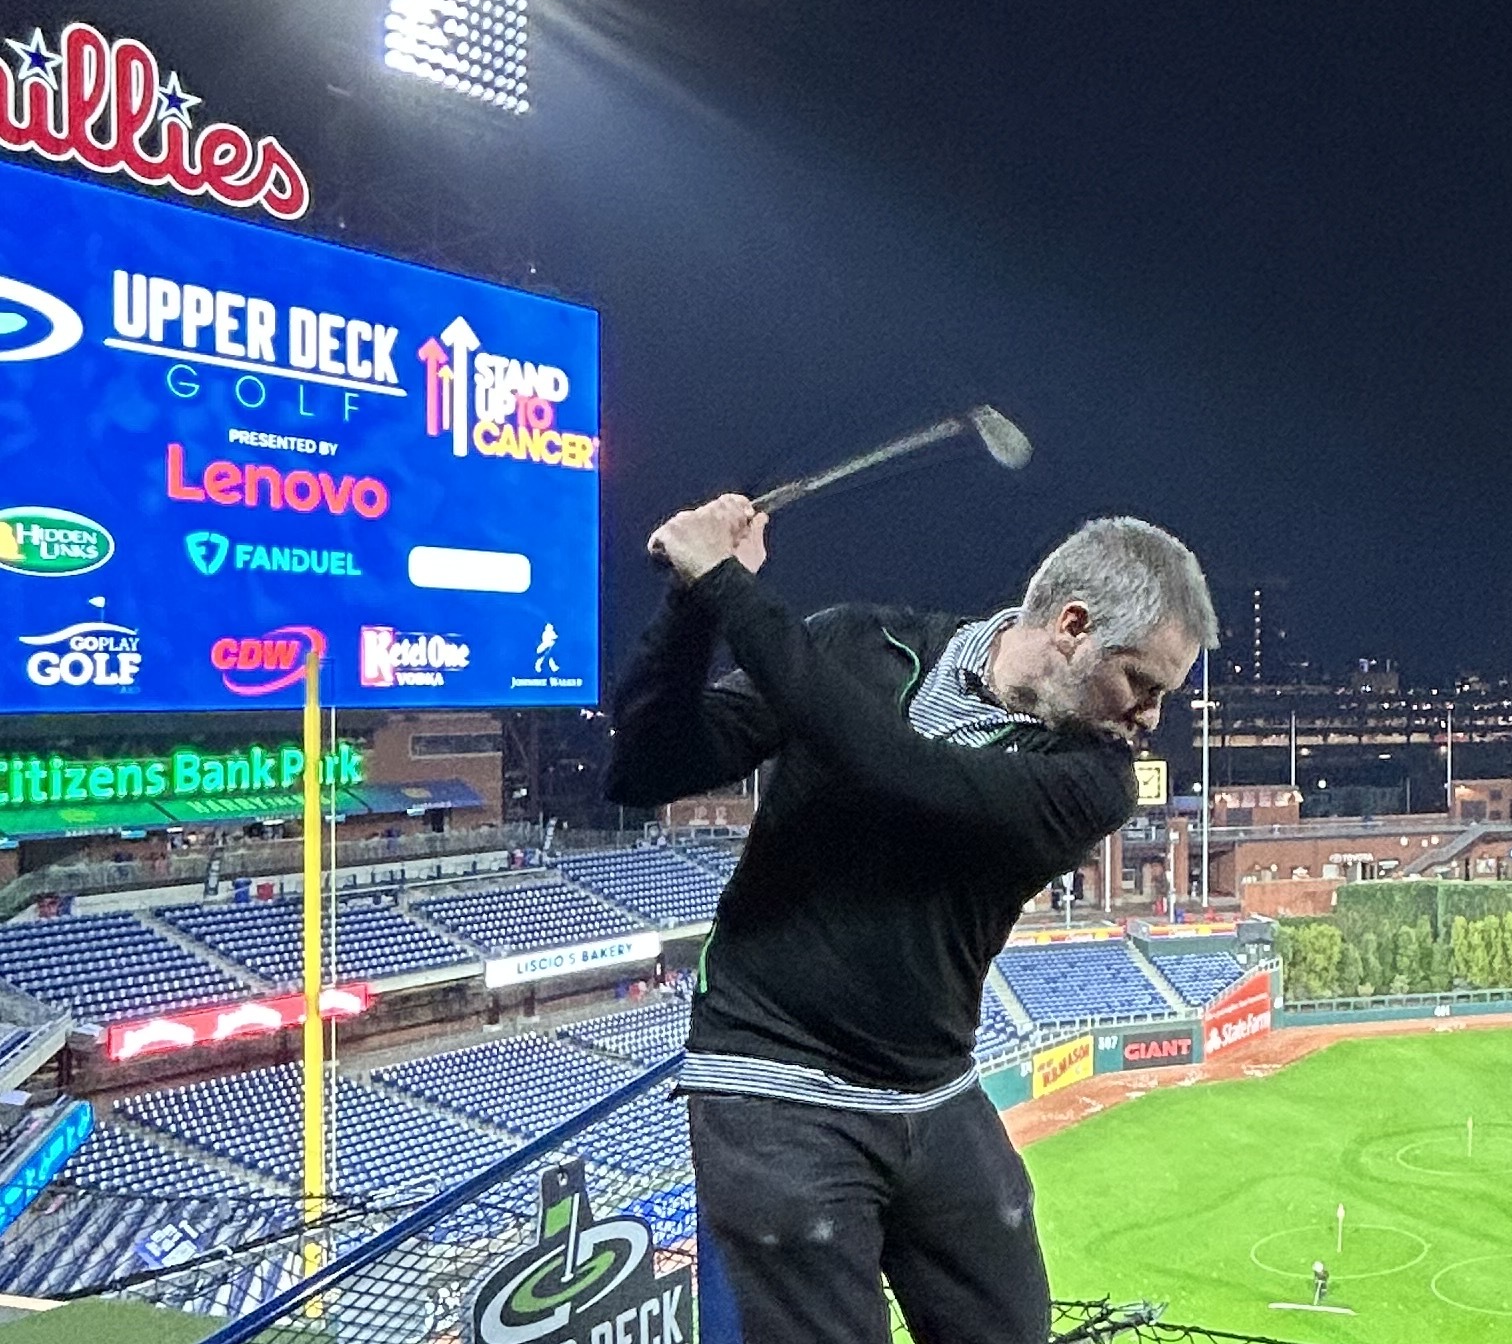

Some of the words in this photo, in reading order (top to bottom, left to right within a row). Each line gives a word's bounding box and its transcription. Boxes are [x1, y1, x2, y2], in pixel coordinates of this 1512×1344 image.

[113, 269, 276, 362] UPPER
[289, 306, 399, 384] DECK
[166, 363, 360, 422] GOLF
[474, 352, 569, 402] STAND
[475, 384, 517, 425] UP
[516, 394, 556, 430] TO
[228, 428, 317, 454] PRESENTED
[318, 440, 338, 456] BY
[473, 419, 594, 469] CANCER
[166, 442, 389, 519] Lenovo
[16, 522, 98, 546] HIDDEN
[40, 541, 99, 560] LINKS
[235, 543, 362, 576] FANDUEL
[27, 651, 142, 686] GOLF
[211, 638, 301, 671] CDW
[427, 634, 470, 669] One
[174, 747, 277, 795] Bank
[280, 741, 365, 787] Prk
[517, 953, 576, 974] LISCIOS
[581, 943, 633, 962] BAKERY
[1124, 1038, 1192, 1061] GIANT
